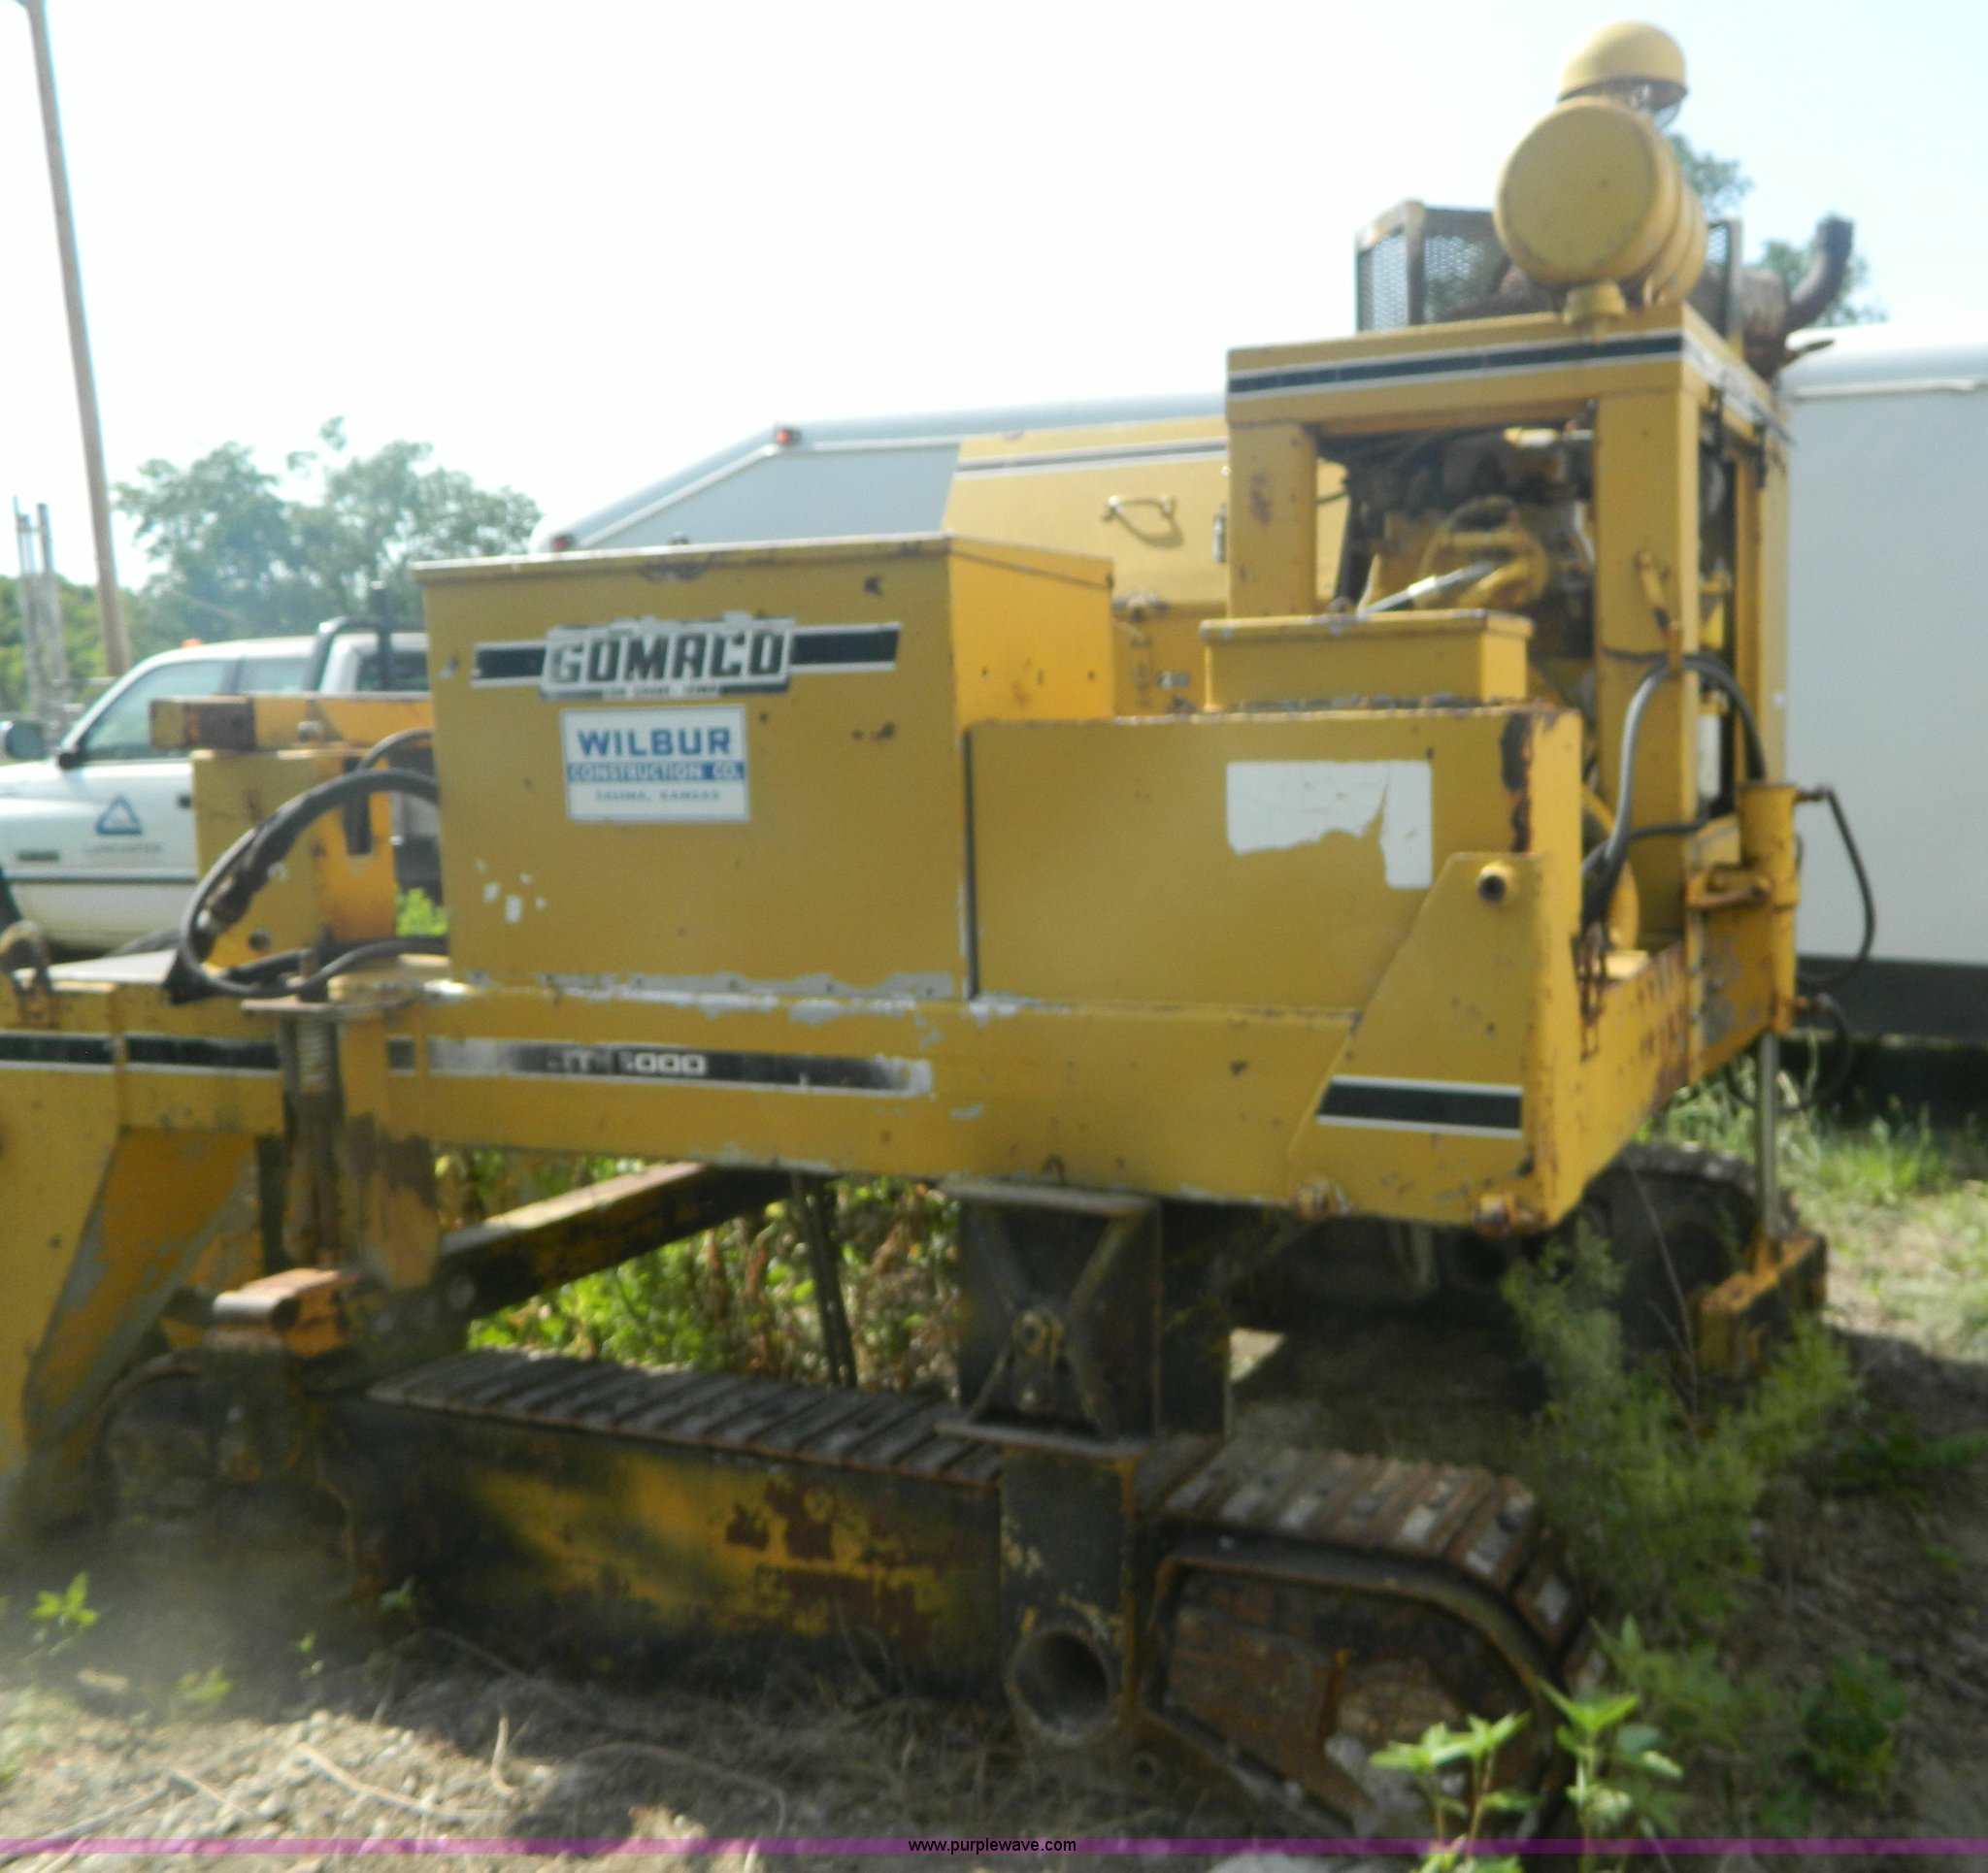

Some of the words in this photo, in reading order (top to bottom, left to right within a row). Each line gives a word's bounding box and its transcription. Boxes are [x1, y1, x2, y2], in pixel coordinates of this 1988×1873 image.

[548, 633, 784, 682] GOMACO
[577, 728, 732, 757] WILBUR
[569, 762, 704, 780] CONSTRUCTION
